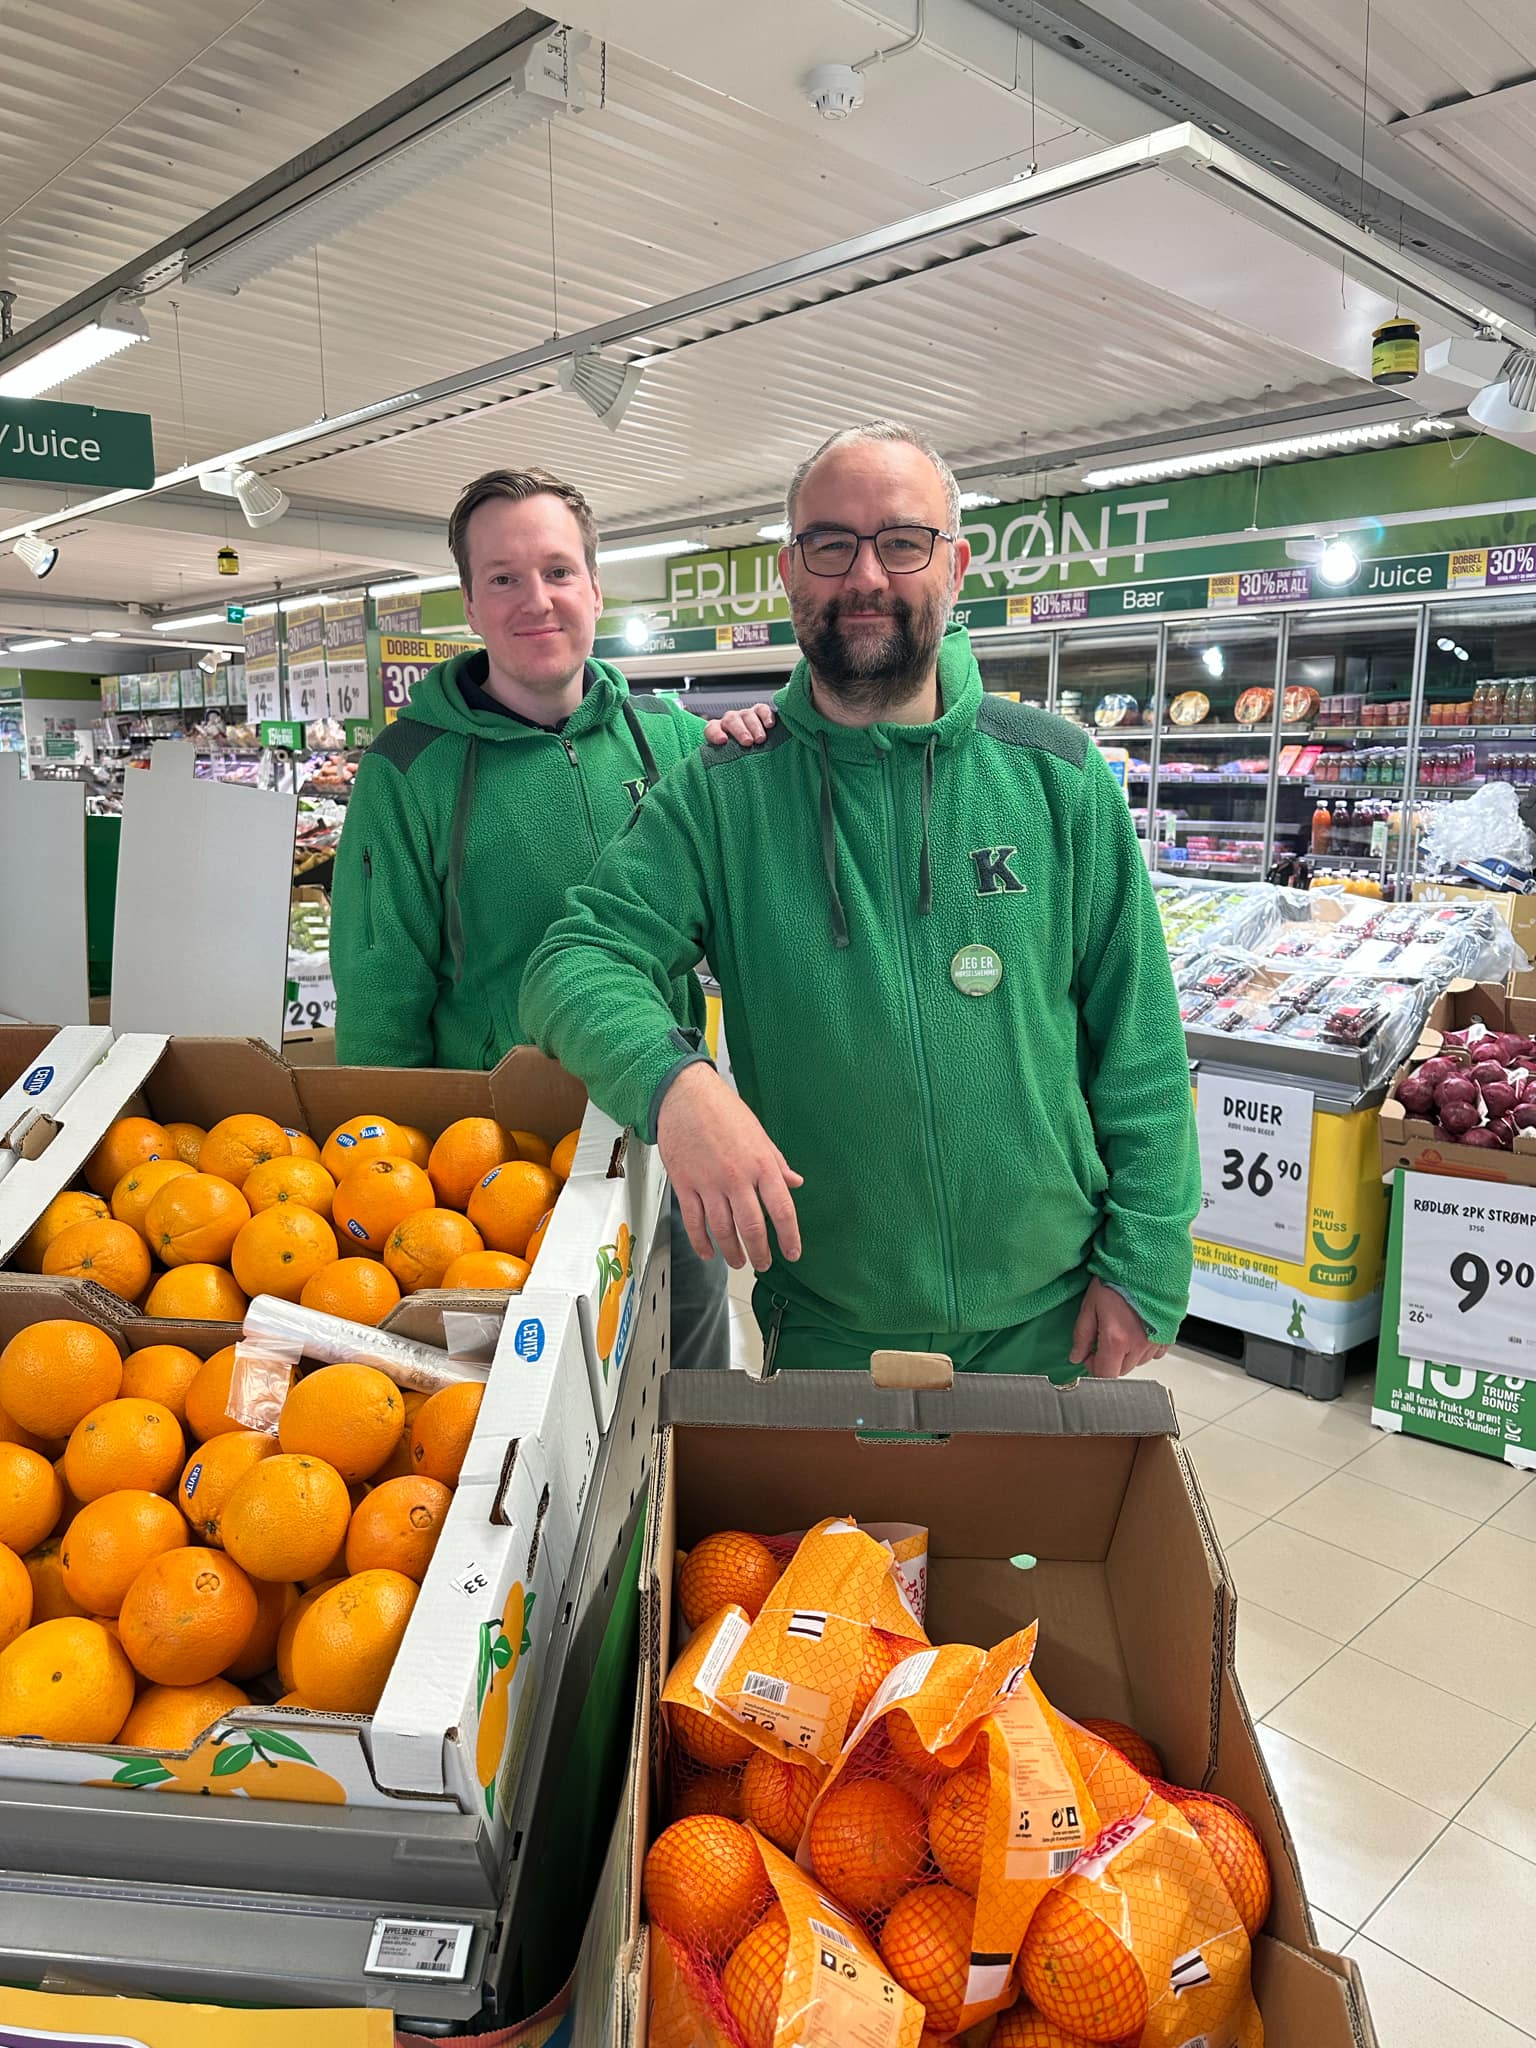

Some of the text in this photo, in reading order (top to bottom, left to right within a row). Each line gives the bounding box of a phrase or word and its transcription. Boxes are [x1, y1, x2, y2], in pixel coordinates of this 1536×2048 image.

[670, 498, 1169, 622] FRUK RØNT
[1453, 554, 1482, 566] DOBBEL
[1490, 547, 1534, 576] 30%
[1240, 572, 1276, 597] 30%
[1369, 564, 1433, 588] Juice
[1032, 594, 1060, 616] 30%
[1122, 590, 1165, 609] Bær
[387, 640, 432, 657] DOBBEL
[255, 692, 267, 717] 14
[301, 689, 309, 715] 4
[338, 685, 353, 714] 16
[968, 845, 1027, 898] K
[960, 956, 993, 970] JEG ER
[289, 1001, 322, 1026] 29
[28, 1069, 51, 1092] CEVITA
[1223, 1096, 1283, 1126] DRUER
[1221, 1148, 1302, 1197] 36 90
[1313, 1207, 1335, 1220] KIWI
[1413, 1198, 1536, 1227] RØDLØK 2PK STRØMP
[1312, 1218, 1347, 1233] PLUSS
[1193, 1244, 1279, 1277] ersk frukt og grønt
[1211, 1260, 1278, 1291] PLUSS-kunder!
[1450, 1251, 1535, 1313] 9 90
[1409, 1310, 1425, 1323] 26
[522, 1322, 538, 1358] CEVITA
[1481, 1395, 1519, 1414] BONUS
[1482, 1384, 1526, 1402] TRUMF-
[1391, 1388, 1402, 1400] på
[1404, 1391, 1415, 1401] all
[1416, 1393, 1438, 1409] fersk
[1440, 1399, 1463, 1415] frukt
[1464, 1408, 1475, 1421] og
[1476, 1412, 1501, 1425] grønt
[1391, 1399, 1400, 1410] til
[1401, 1401, 1416, 1415] alle
[1417, 1406, 1437, 1420] KIWI
[1438, 1410, 1501, 1438] PLUSS-kunder!
[1018, 1810, 1030, 1832] 5
[383, 1926, 418, 1937] APPELSINER
[434, 1939, 448, 1962] 7
